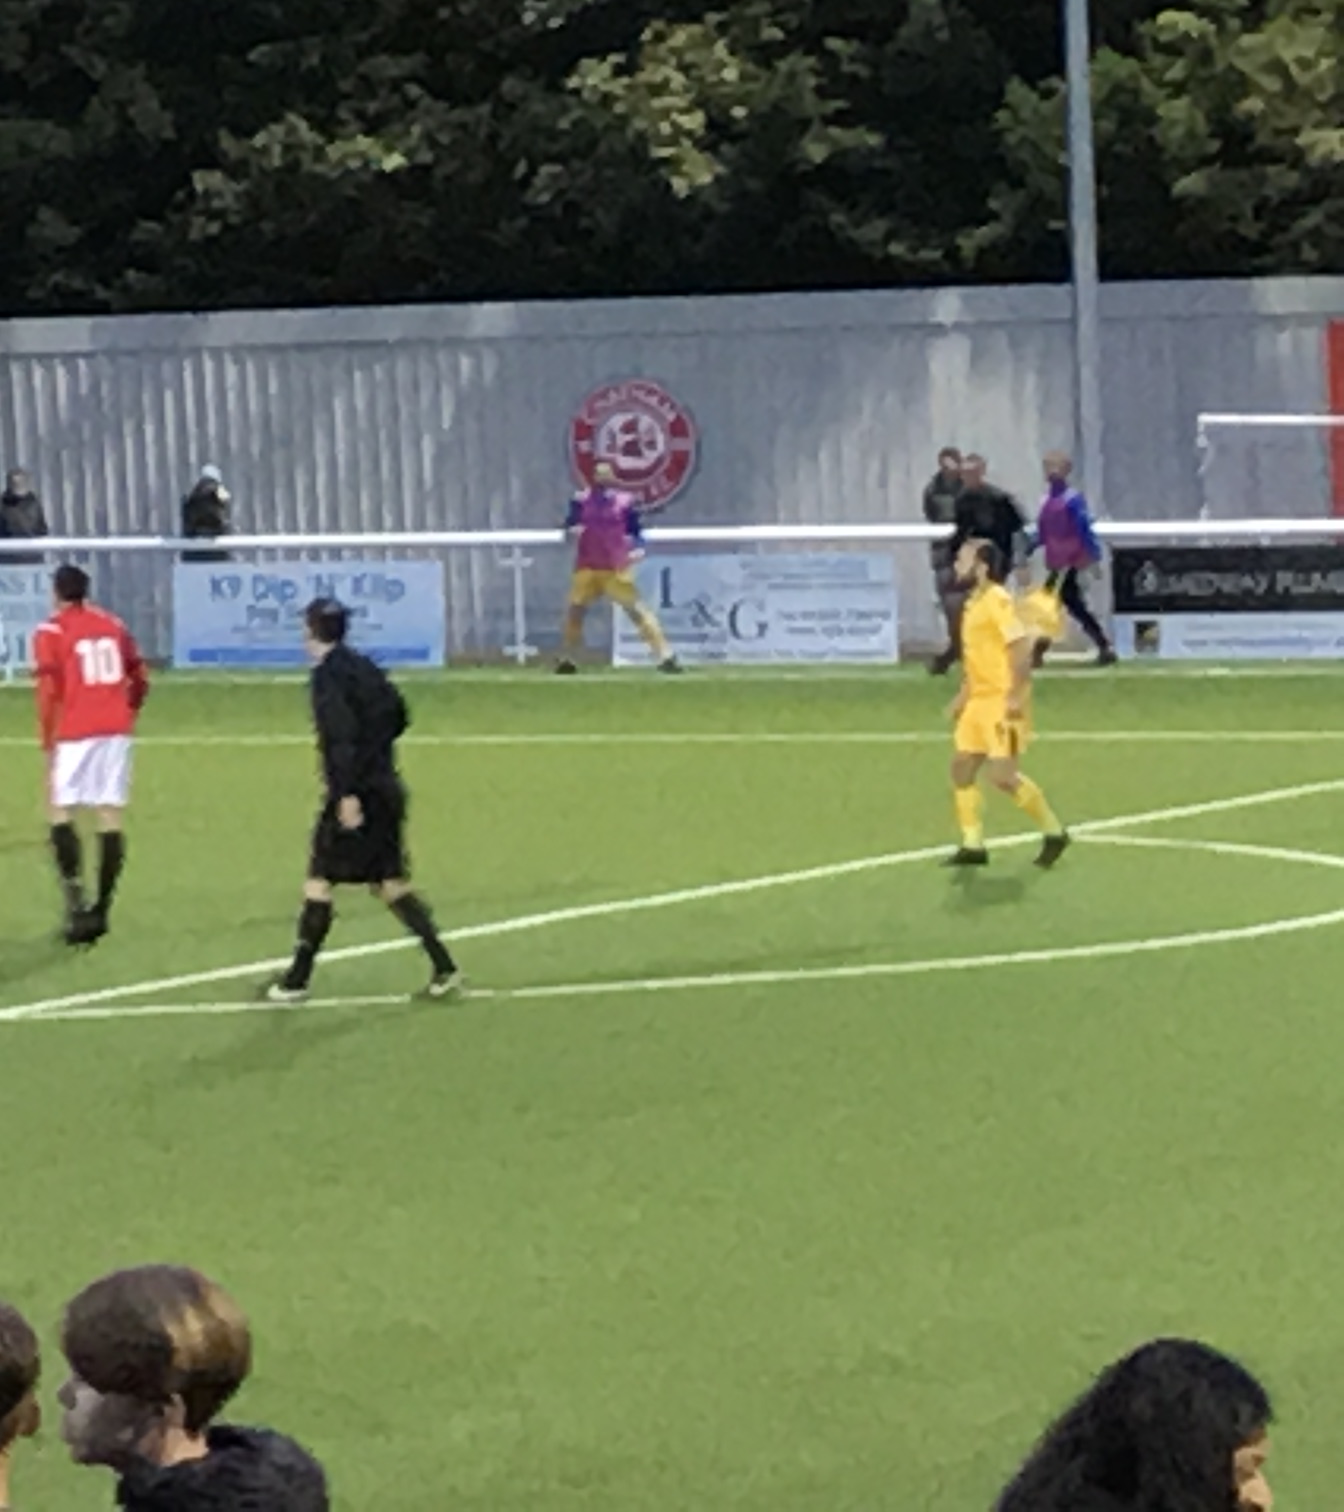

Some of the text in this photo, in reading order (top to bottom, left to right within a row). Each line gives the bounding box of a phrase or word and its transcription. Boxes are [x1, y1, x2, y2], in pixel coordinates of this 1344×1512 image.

[686, 594, 726, 628] &
[728, 596, 769, 641] G
[74, 637, 123, 686] 10
